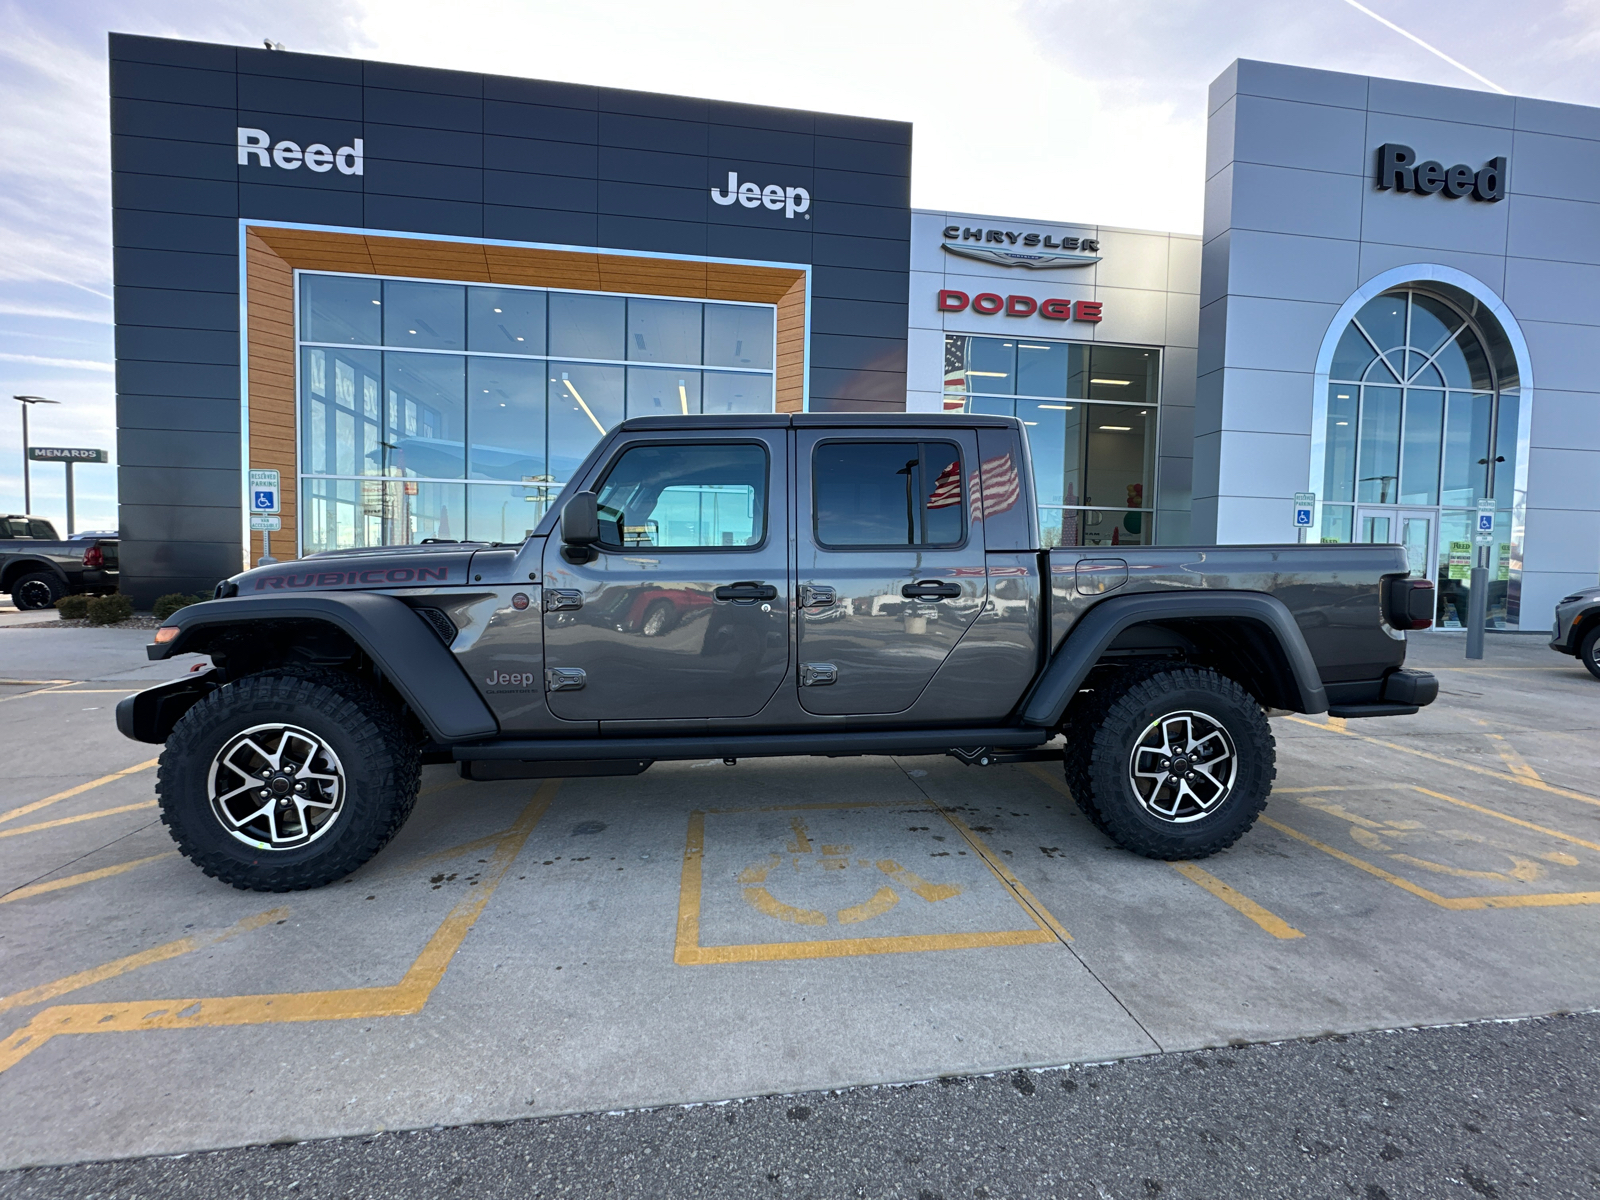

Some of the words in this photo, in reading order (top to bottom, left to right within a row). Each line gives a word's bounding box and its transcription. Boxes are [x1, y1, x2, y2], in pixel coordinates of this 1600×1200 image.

[237, 127, 364, 176] Reed
[1377, 142, 1507, 202] Reed
[711, 171, 810, 219] Jeep
[943, 225, 1100, 251] CHRYSLER
[938, 289, 1103, 323] DODGE
[34, 448, 97, 458] MENARDS
[251, 480, 277, 488] PARKING
[254, 567, 449, 591] RUBICON
[485, 670, 535, 688] Jeep
